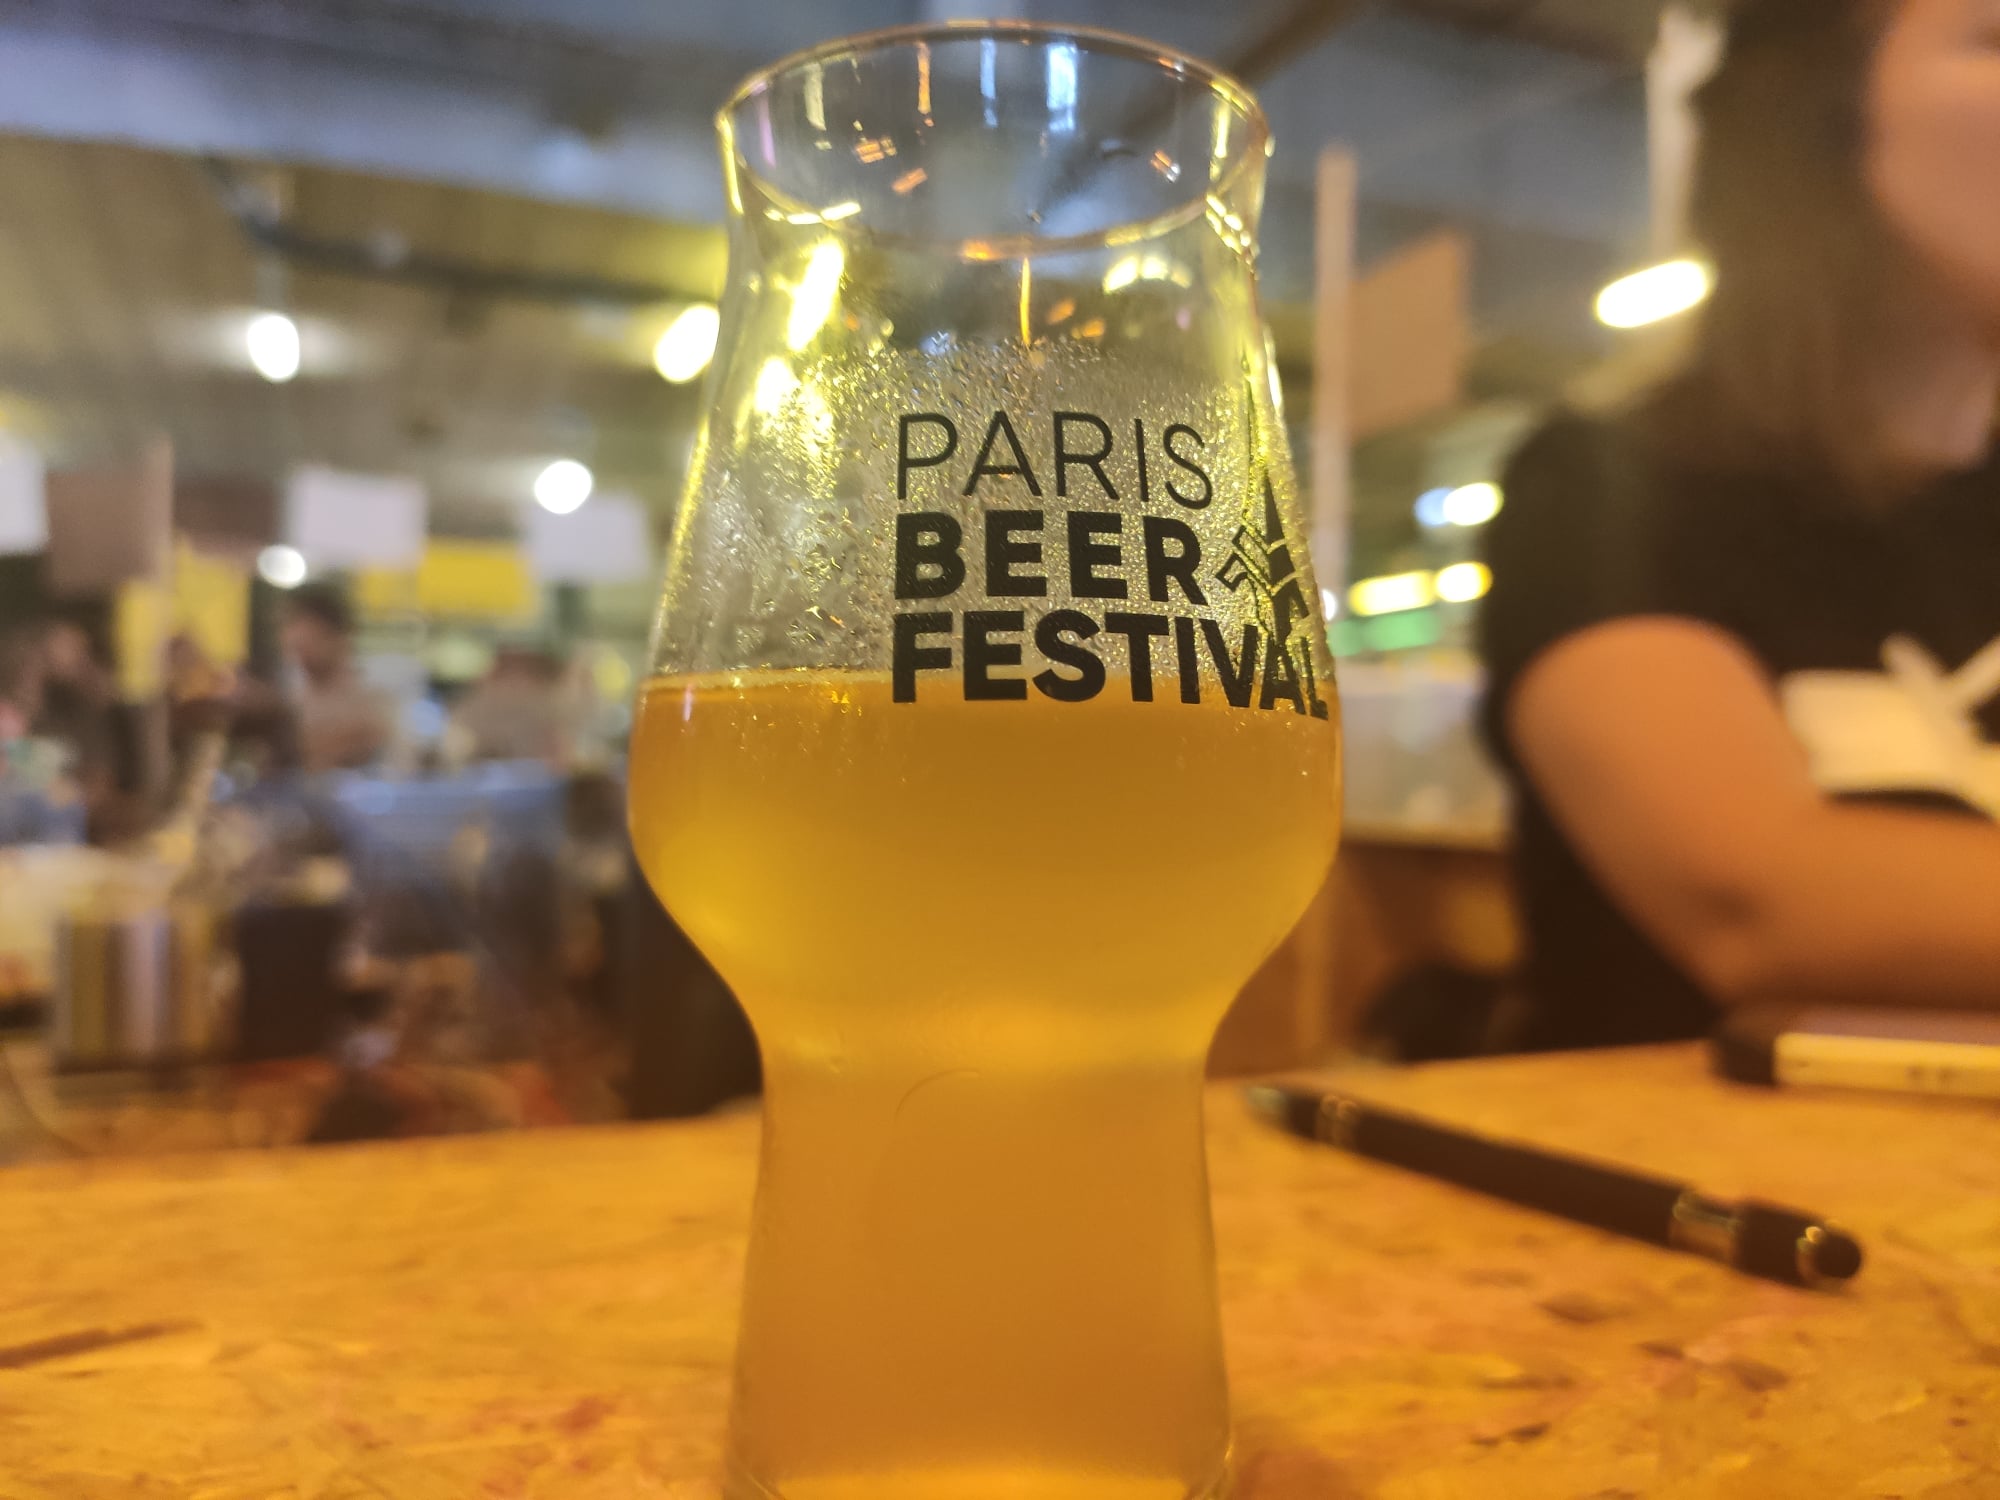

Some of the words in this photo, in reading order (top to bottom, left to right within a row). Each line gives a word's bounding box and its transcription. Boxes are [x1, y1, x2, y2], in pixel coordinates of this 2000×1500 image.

[897, 411, 1213, 509] PARIS
[894, 509, 1209, 606] BEER
[892, 609, 1329, 721] FESTIVAL
